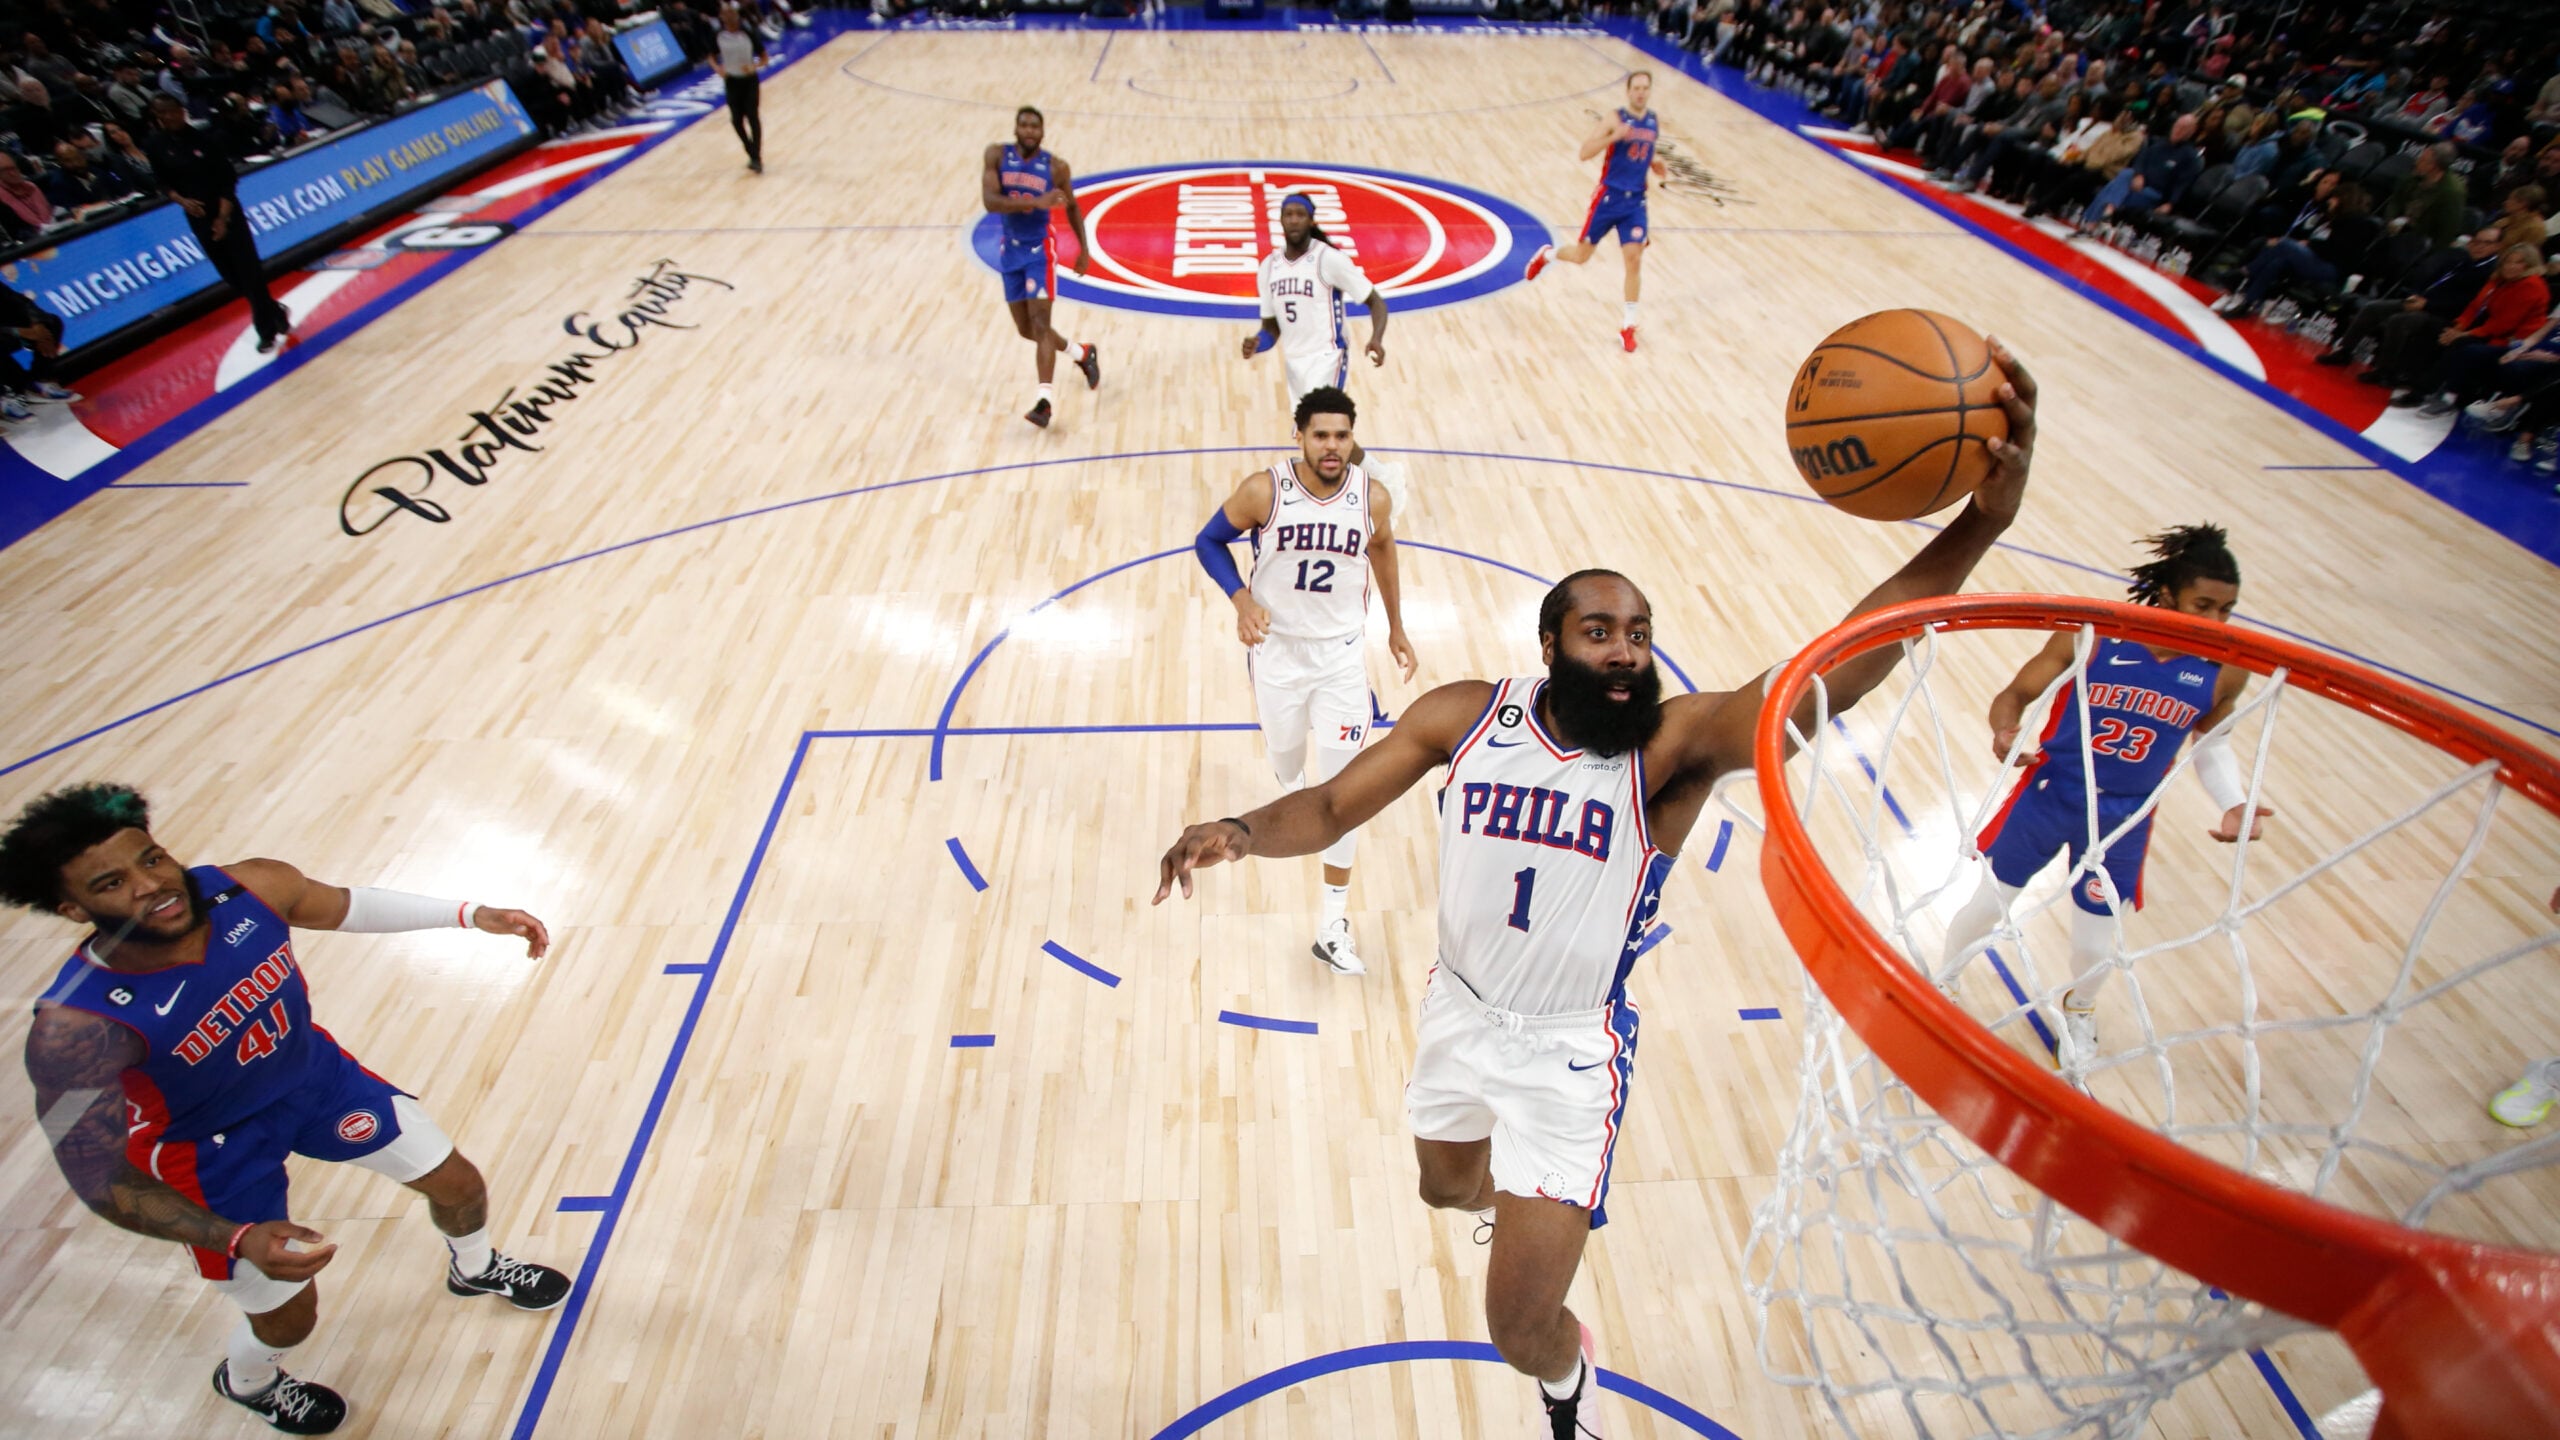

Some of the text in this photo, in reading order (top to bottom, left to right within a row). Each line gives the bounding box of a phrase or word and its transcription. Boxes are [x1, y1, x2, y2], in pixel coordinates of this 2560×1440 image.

[340, 156, 391, 190] PLAY
[388, 132, 448, 171] GAMES
[443, 107, 505, 147] ONLINE!
[1172, 184, 1260, 278] DETROIT
[1270, 278, 1314, 298] PHILA
[1284, 301, 1298, 324] 5
[340, 352, 596, 537] Platinum
[562, 257, 736, 358] Equity
[1277, 522, 1361, 558] PHILA
[1294, 559, 1336, 593] 12
[2178, 670, 2204, 684] UWM
[1501, 706, 1520, 726] 6
[2088, 682, 2200, 729] DETROIT
[1339, 724, 1361, 742] 76
[2090, 716, 2157, 763] 23
[1461, 782, 1615, 863] PHILA
[214, 892, 230, 905] 16
[1508, 866, 1537, 933] 1
[223, 917, 257, 945] UWM
[108, 987, 133, 1006] 6
[171, 940, 296, 1067] DETROIT
[236, 998, 292, 1067] 41
